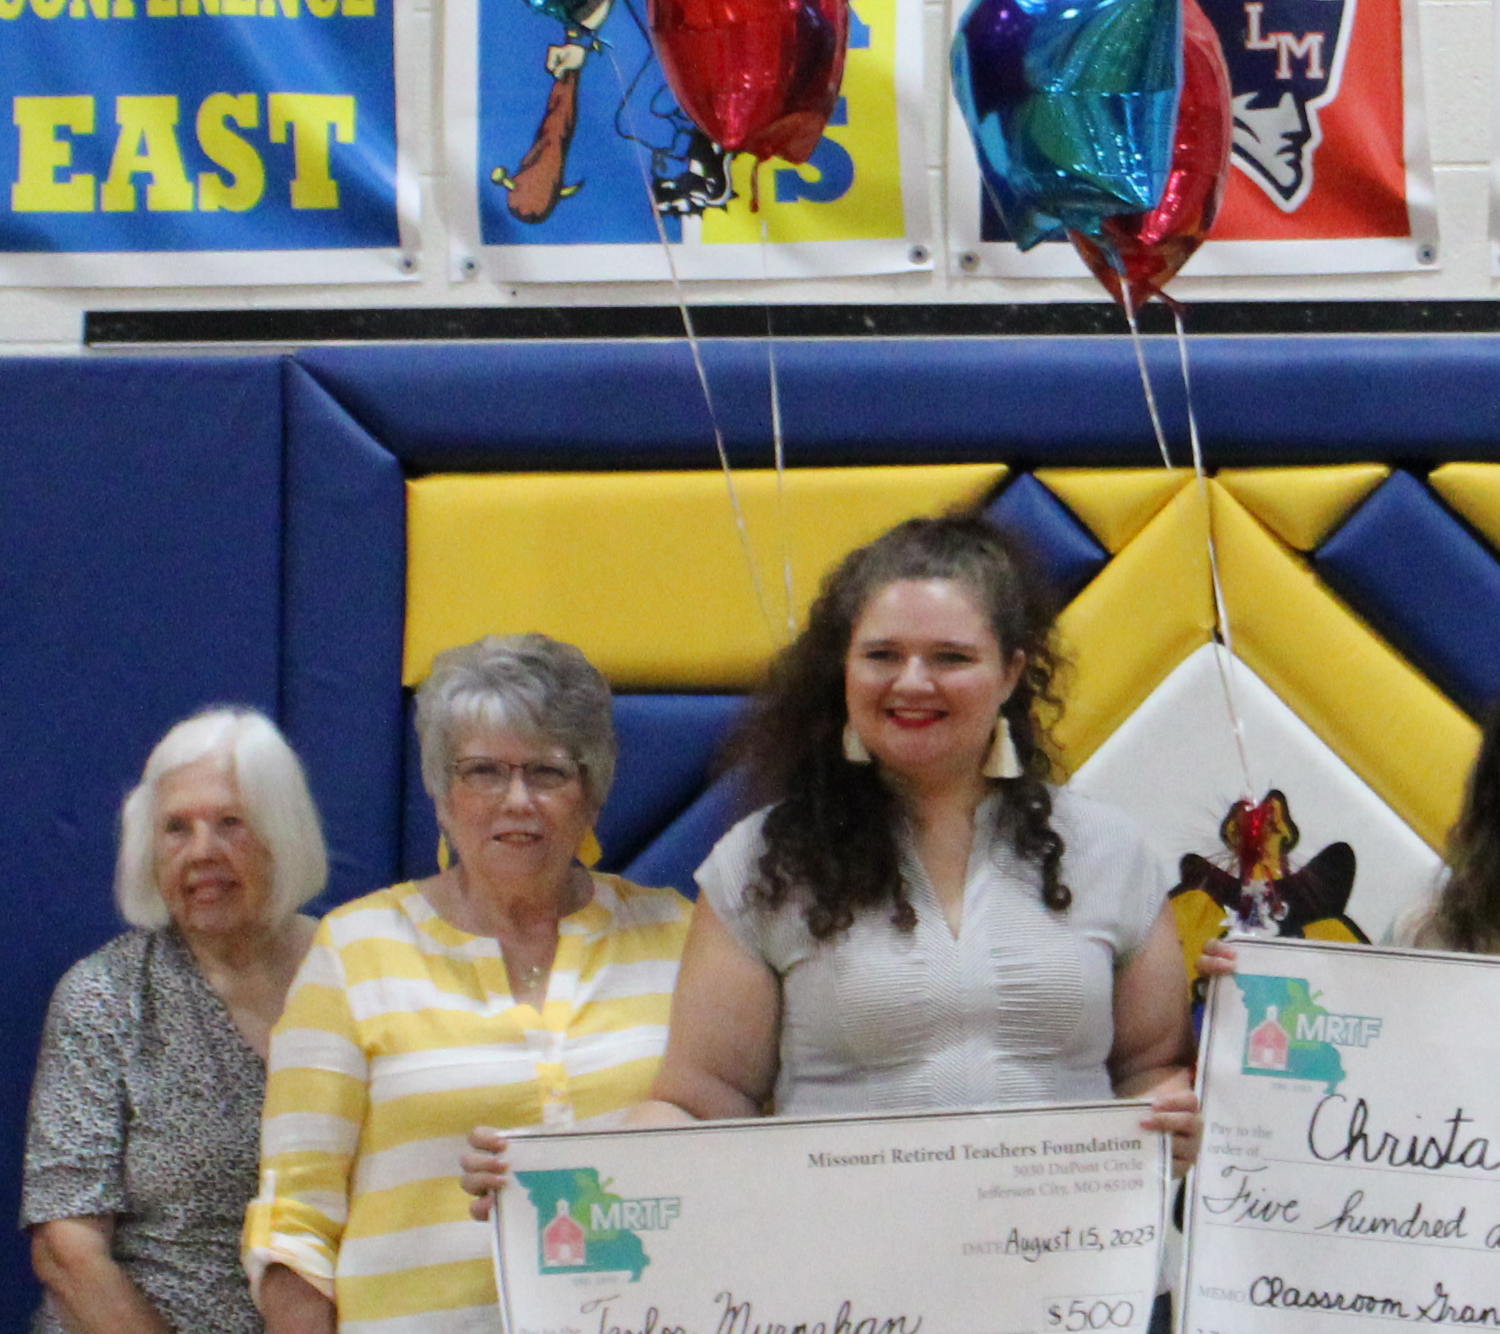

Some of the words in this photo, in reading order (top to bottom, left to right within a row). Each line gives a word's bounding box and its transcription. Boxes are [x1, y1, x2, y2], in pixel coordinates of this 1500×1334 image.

[10, 91, 358, 215] EAST
[1294, 1013, 1384, 1048] MRTF
[807, 1148, 885, 1168] Missouri
[890, 1145, 956, 1164] Retired
[961, 1141, 1038, 1161] Teachers
[1040, 1136, 1143, 1157] Foundation
[589, 1196, 682, 1232] MRTF
[1202, 1164, 1300, 1227] Five
[1314, 1190, 1468, 1241] hundred
[1003, 1225, 1073, 1264] August
[1078, 1226, 1105, 1252] 15,
[1109, 1224, 1156, 1247] 2023
[1046, 1299, 1135, 1333] $500
[1248, 1274, 1411, 1320] Classroom
